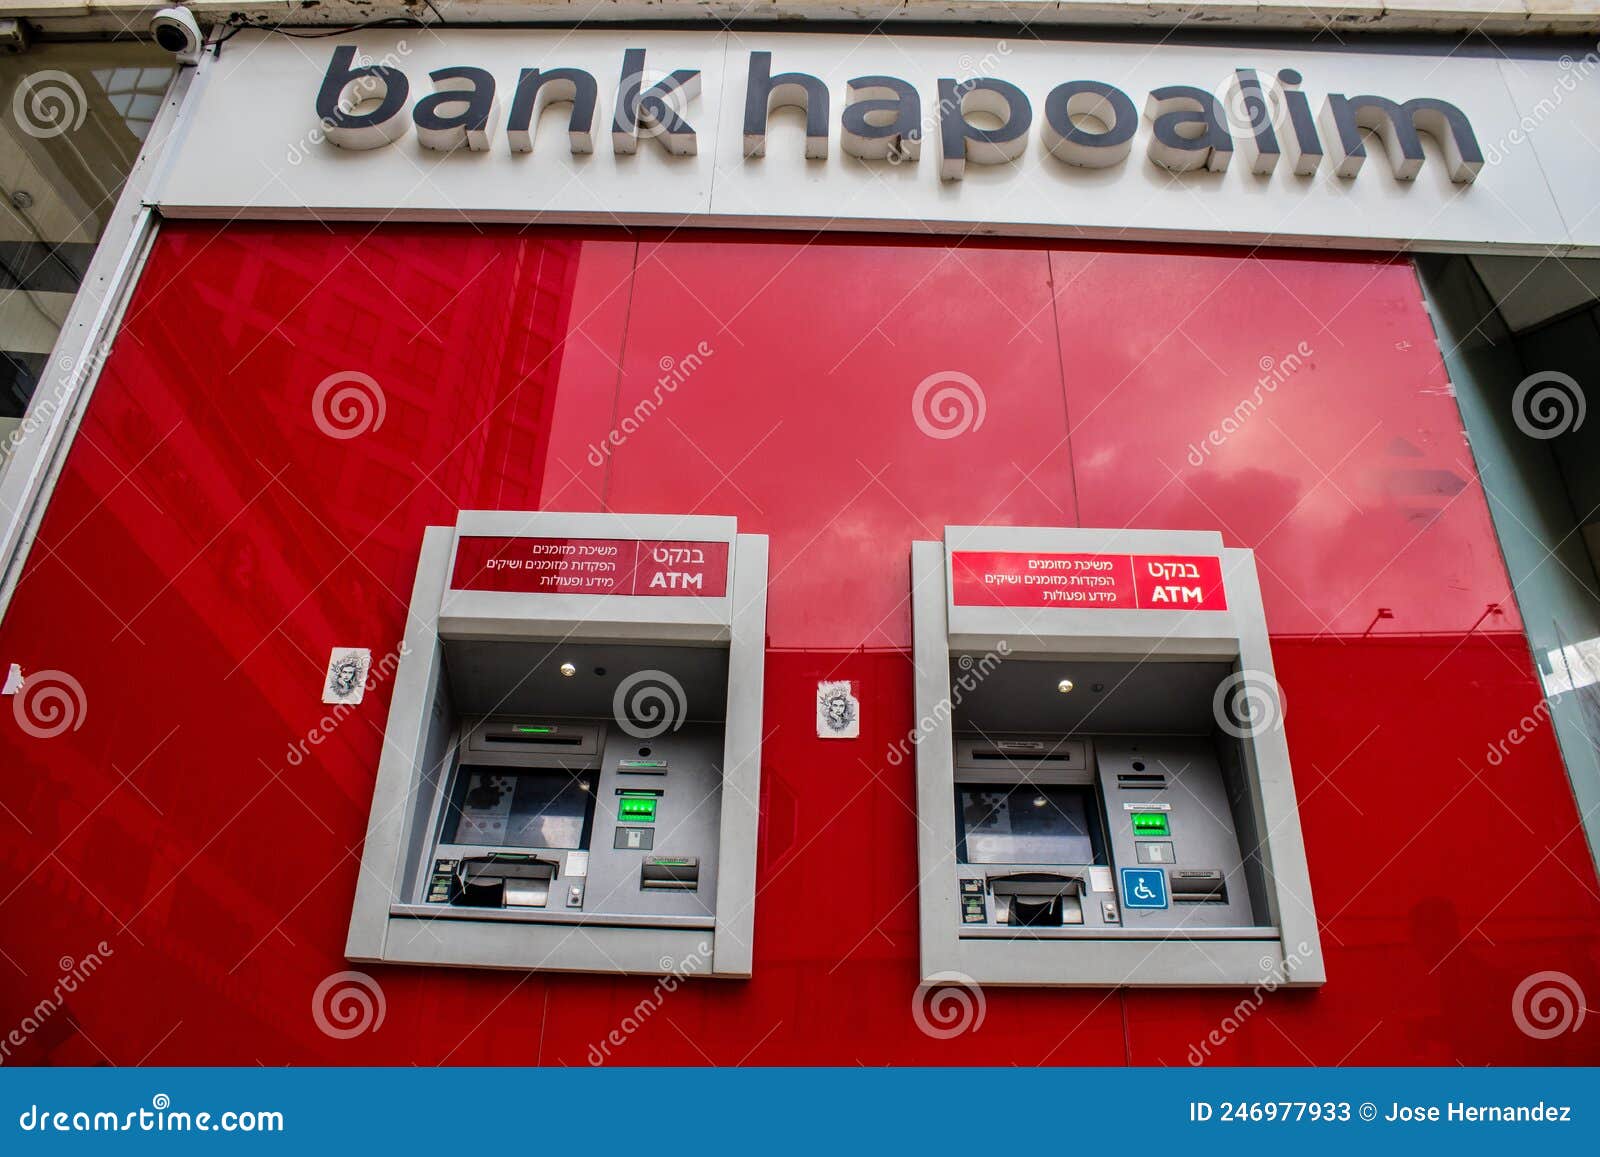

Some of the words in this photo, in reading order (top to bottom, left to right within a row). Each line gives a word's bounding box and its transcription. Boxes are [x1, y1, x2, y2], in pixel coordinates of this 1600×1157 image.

[316, 45, 702, 153] bank
[743, 51, 1485, 182] hapoalim
[532, 544, 576, 555] מזומנים
[578, 545, 617, 556] משיכת
[652, 547, 704, 567] בנקט
[486, 558, 522, 571] ושיקים
[525, 560, 567, 571] מזומנים
[570, 561, 616, 572] הפקדות
[1028, 559, 1072, 570] מזומנים
[1074, 560, 1113, 571] משיכת
[1148, 561, 1200, 581] בנקט
[539, 574, 583, 587] ופעולות
[585, 576, 614, 587] מידע
[649, 571, 703, 589] ATM
[984, 573, 1021, 586] ושיקים
[1024, 574, 1067, 585] מזומנים
[1069, 575, 1115, 587] הפקדות
[1043, 590, 1086, 602] ופעולות
[1088, 591, 1117, 602] מידע
[1152, 585, 1203, 603] ATM
